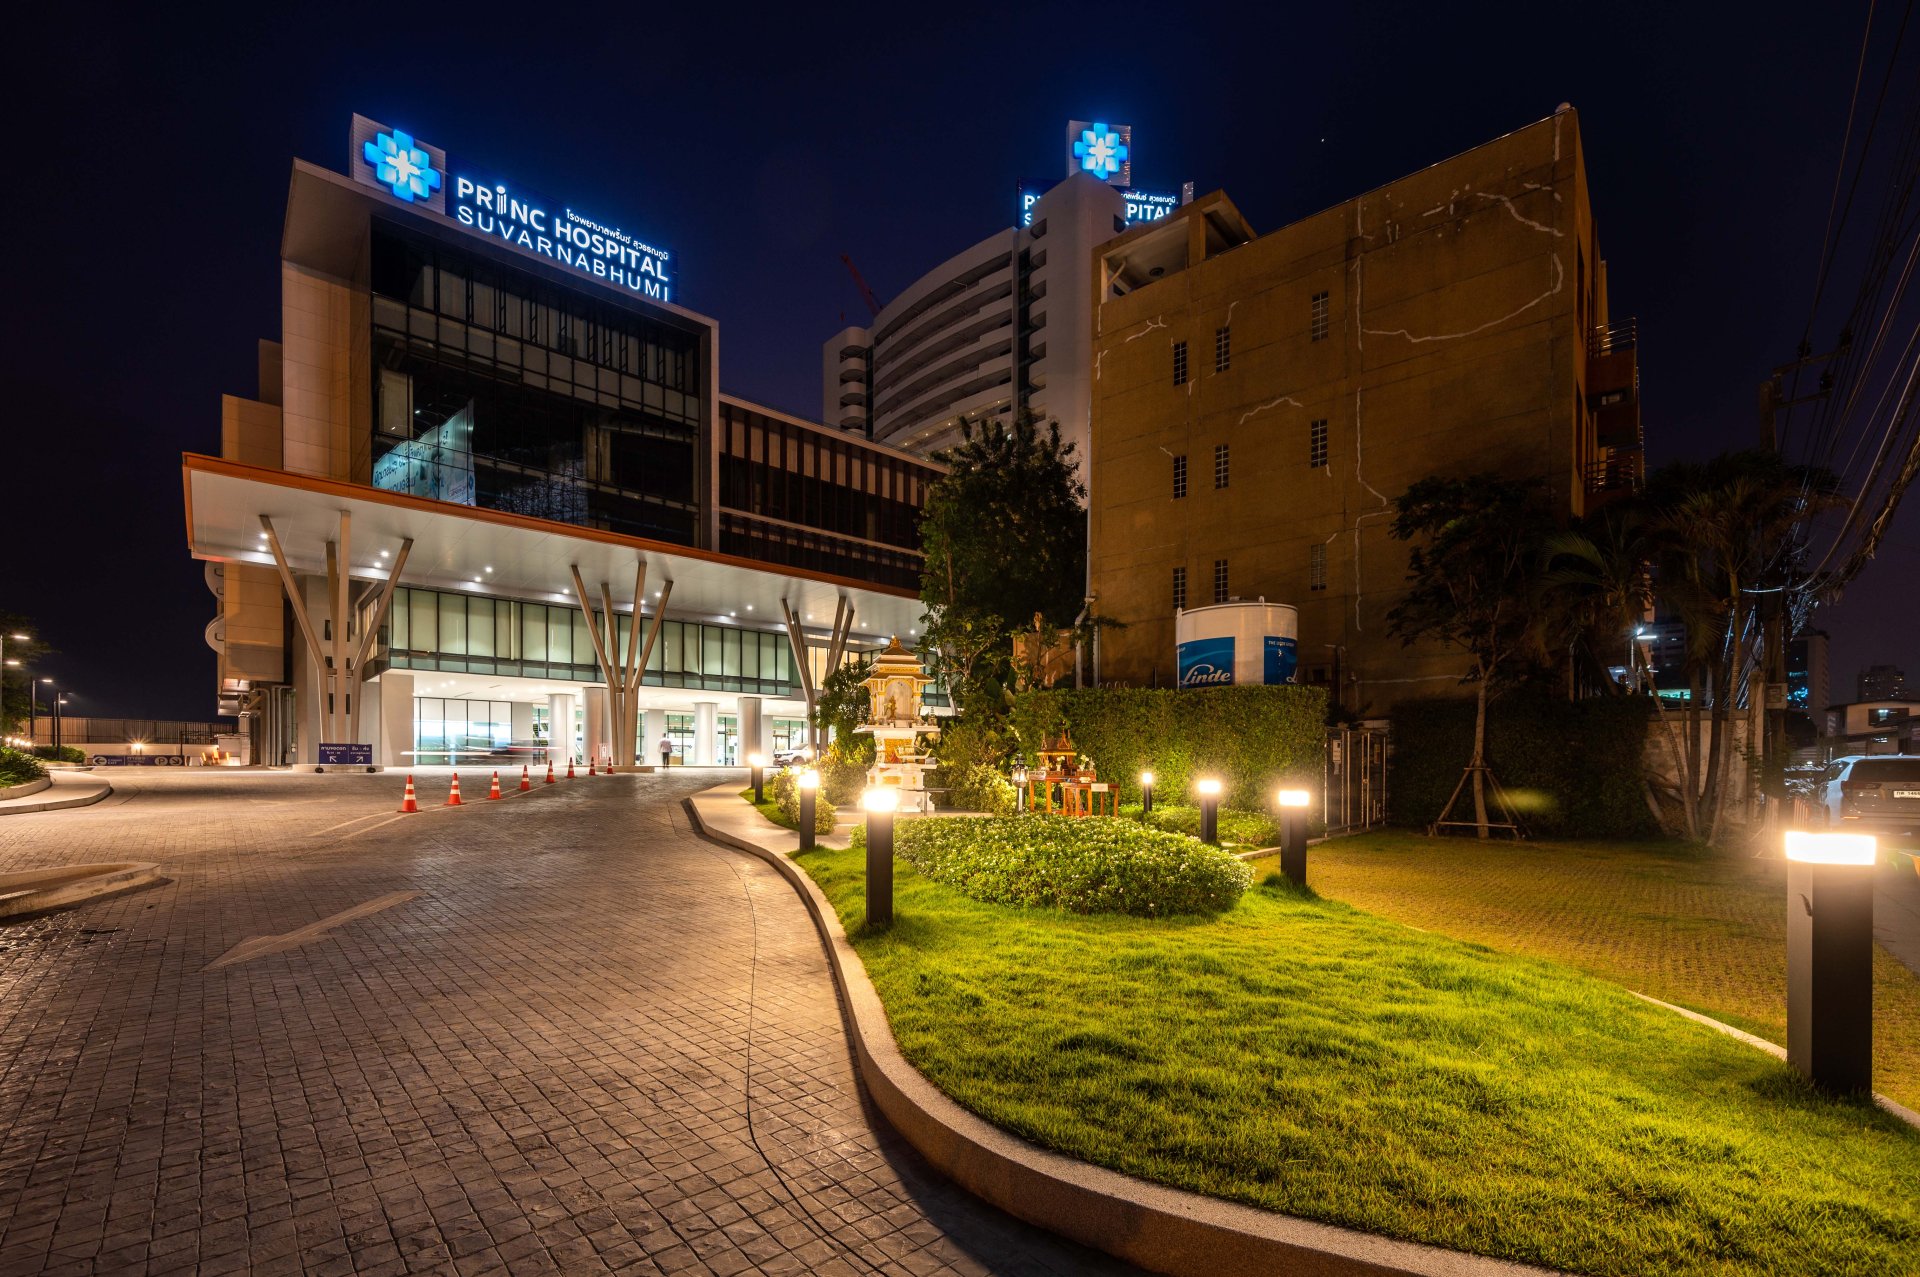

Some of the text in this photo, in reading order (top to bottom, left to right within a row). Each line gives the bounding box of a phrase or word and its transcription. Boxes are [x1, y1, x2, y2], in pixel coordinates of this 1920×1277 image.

[457, 205, 669, 303] SUVARNABHUMI
[555, 217, 669, 282] HOSPITAL
[1180, 663, 1231, 686] Linde
